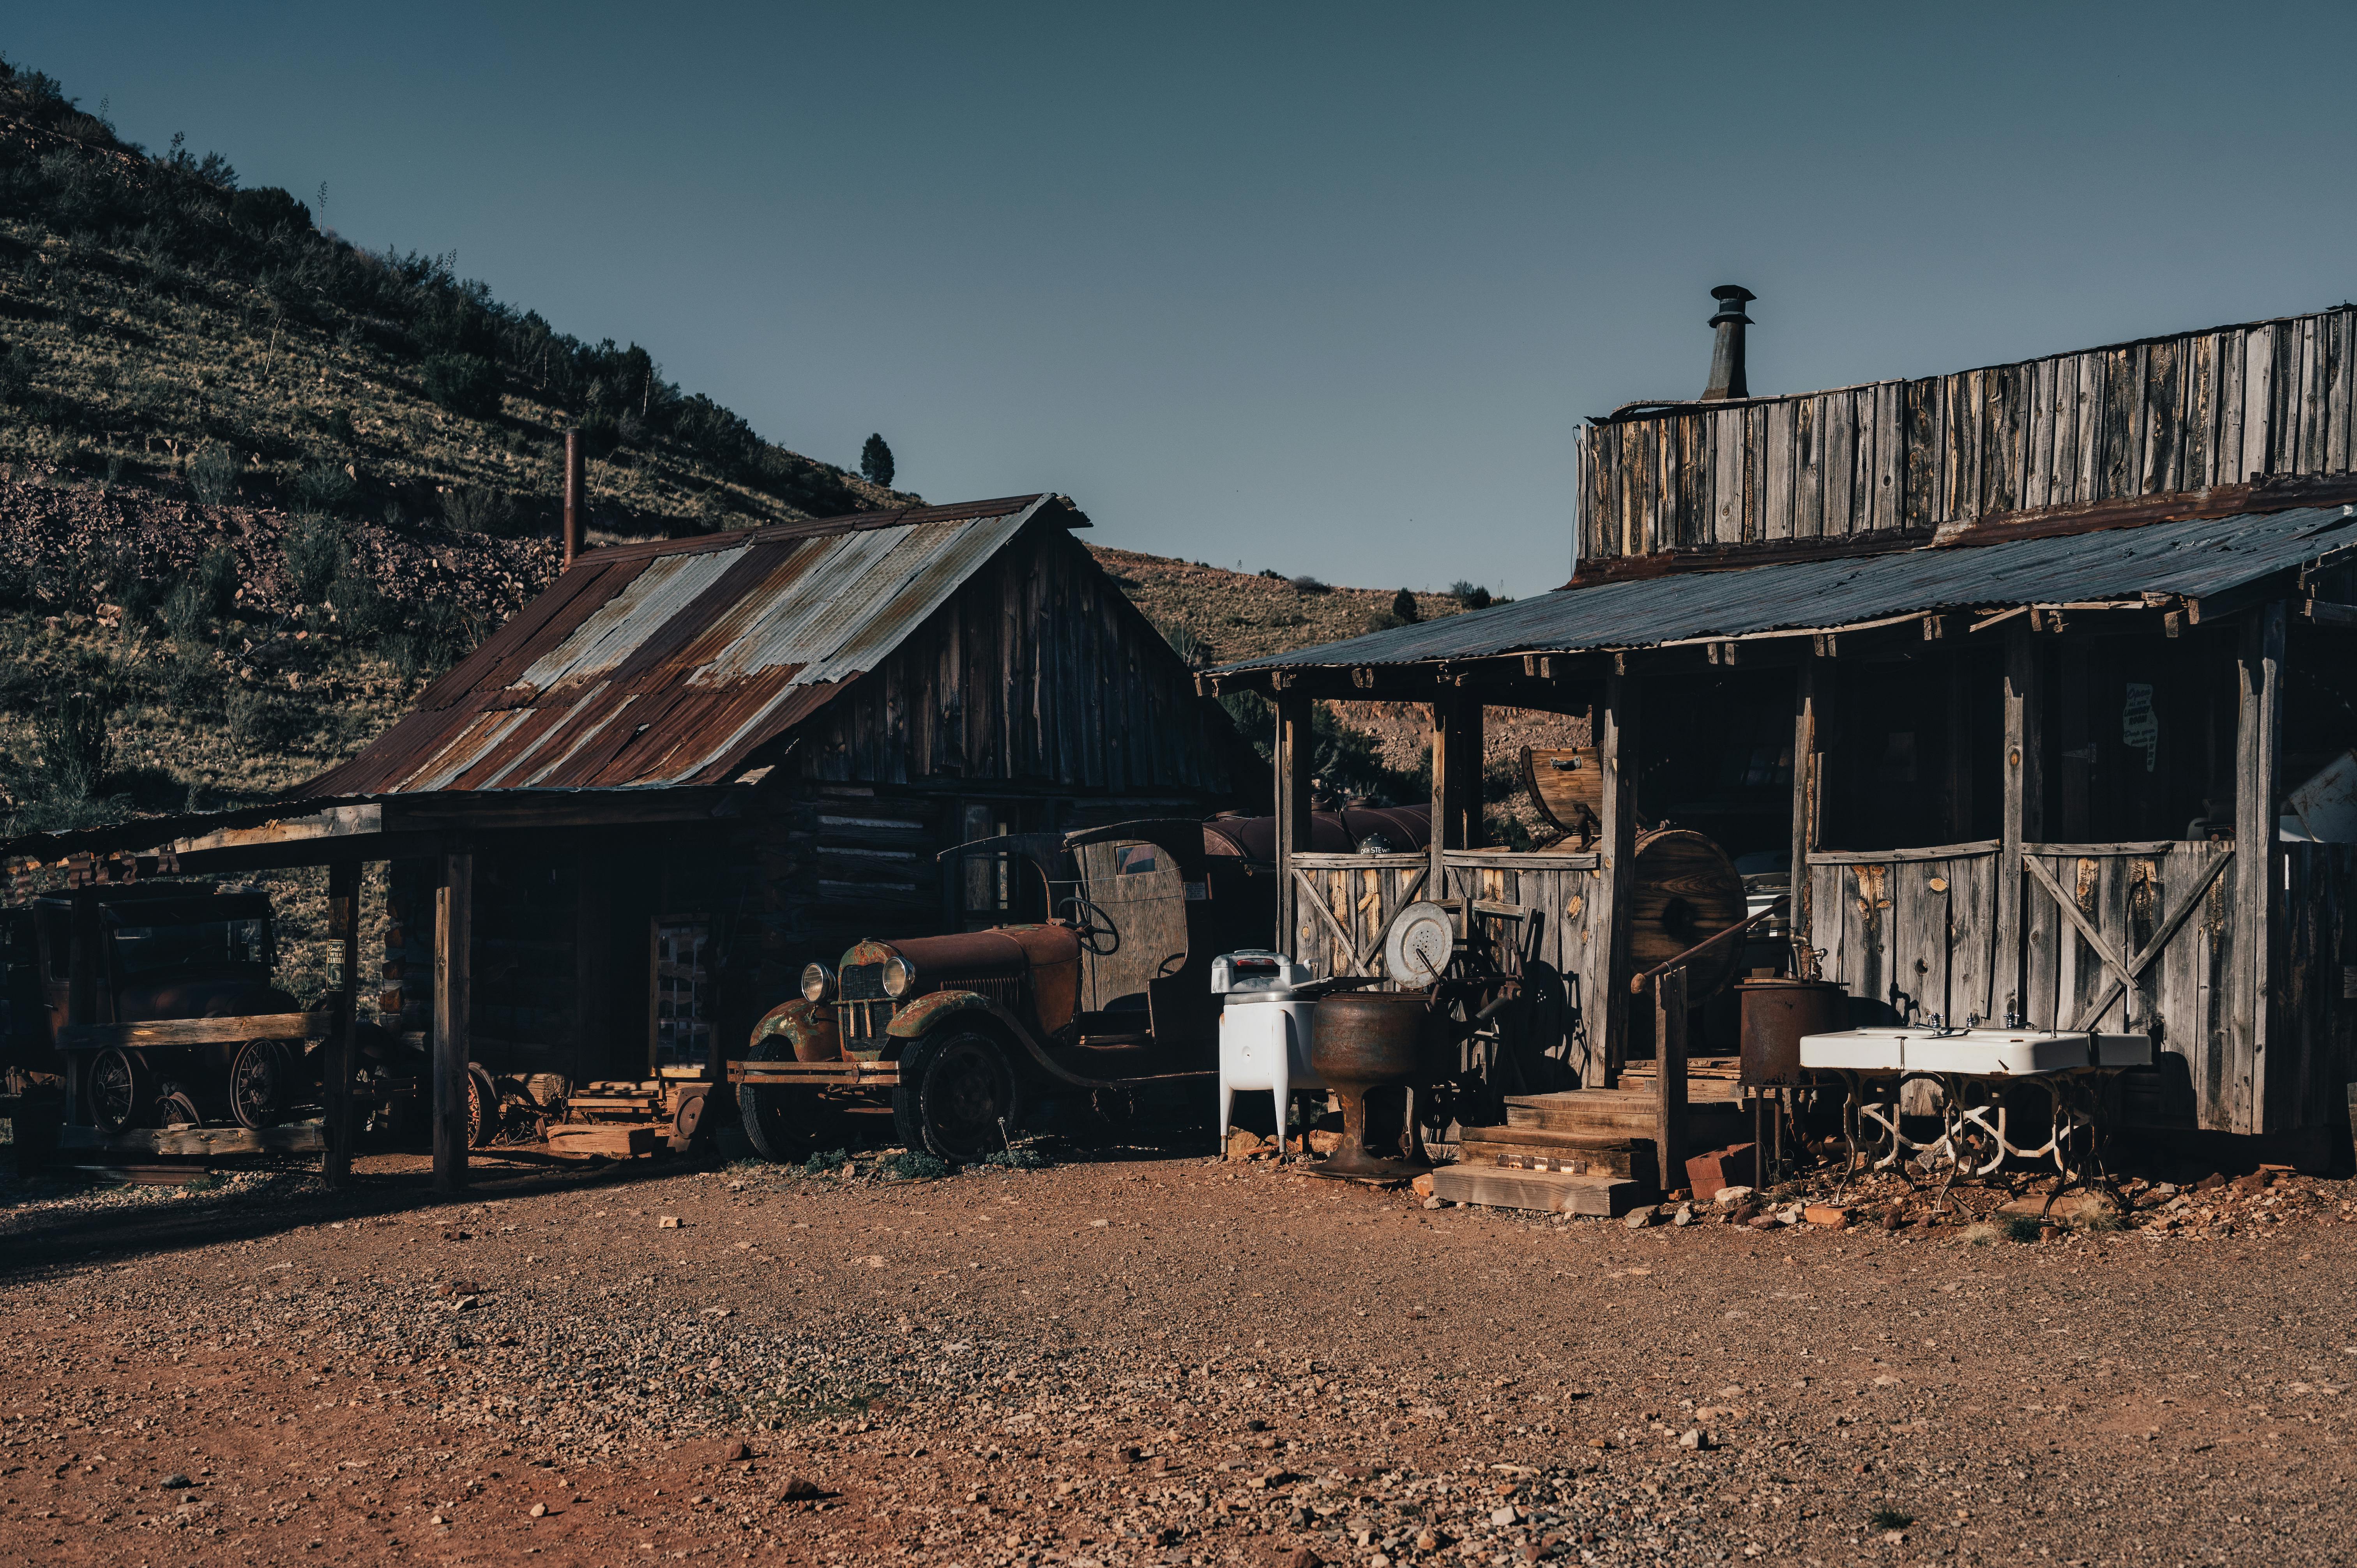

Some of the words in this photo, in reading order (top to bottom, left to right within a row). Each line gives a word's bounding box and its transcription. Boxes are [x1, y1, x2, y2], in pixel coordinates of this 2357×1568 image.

[2127, 688, 2150, 700] Open
[2124, 705, 2150, 717] LAUNDRY
[2129, 715, 2147, 726] ROOM
